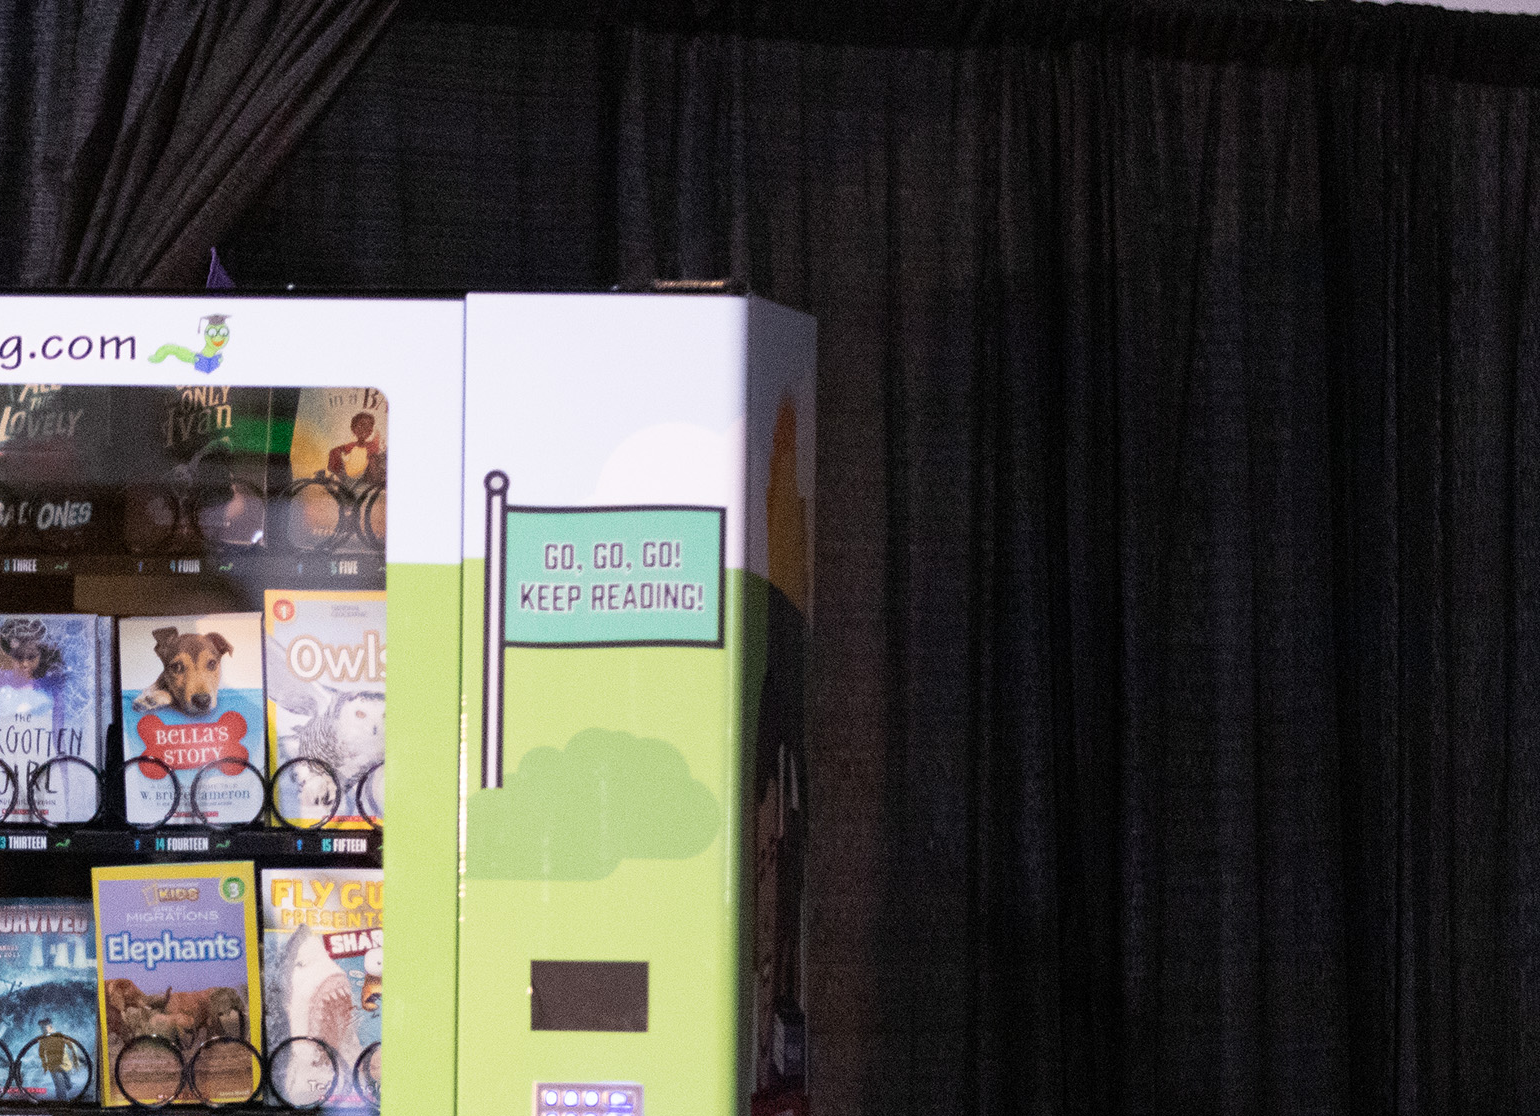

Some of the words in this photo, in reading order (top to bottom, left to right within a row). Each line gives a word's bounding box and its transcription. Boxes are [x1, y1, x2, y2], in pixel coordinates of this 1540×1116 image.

[37, 501, 93, 530] ONES
[544, 543, 584, 573] GO,
[592, 542, 633, 572] GO,
[642, 541, 682, 568] GO!
[12, 558, 37, 572] THREE
[178, 560, 200, 573] FOUR
[339, 561, 359, 574] FIVE
[520, 584, 581, 611] KEEP
[591, 582, 704, 611] READING!
[279, 606, 288, 619] 1
[195, 789, 250, 800] ameron
[9, 836, 47, 849] THIRTEEN
[156, 838, 165, 850] 14
[167, 838, 209, 850] FOURTEEN
[322, 838, 332, 851] 15
[333, 838, 367, 852] FIFTEEN
[159, 888, 200, 901] KIDS
[230, 883, 240, 898] 3
[272, 879, 335, 907] FLY
[126, 911, 219, 923] MIGRATIONS
[108, 932, 241, 968] Elephants
